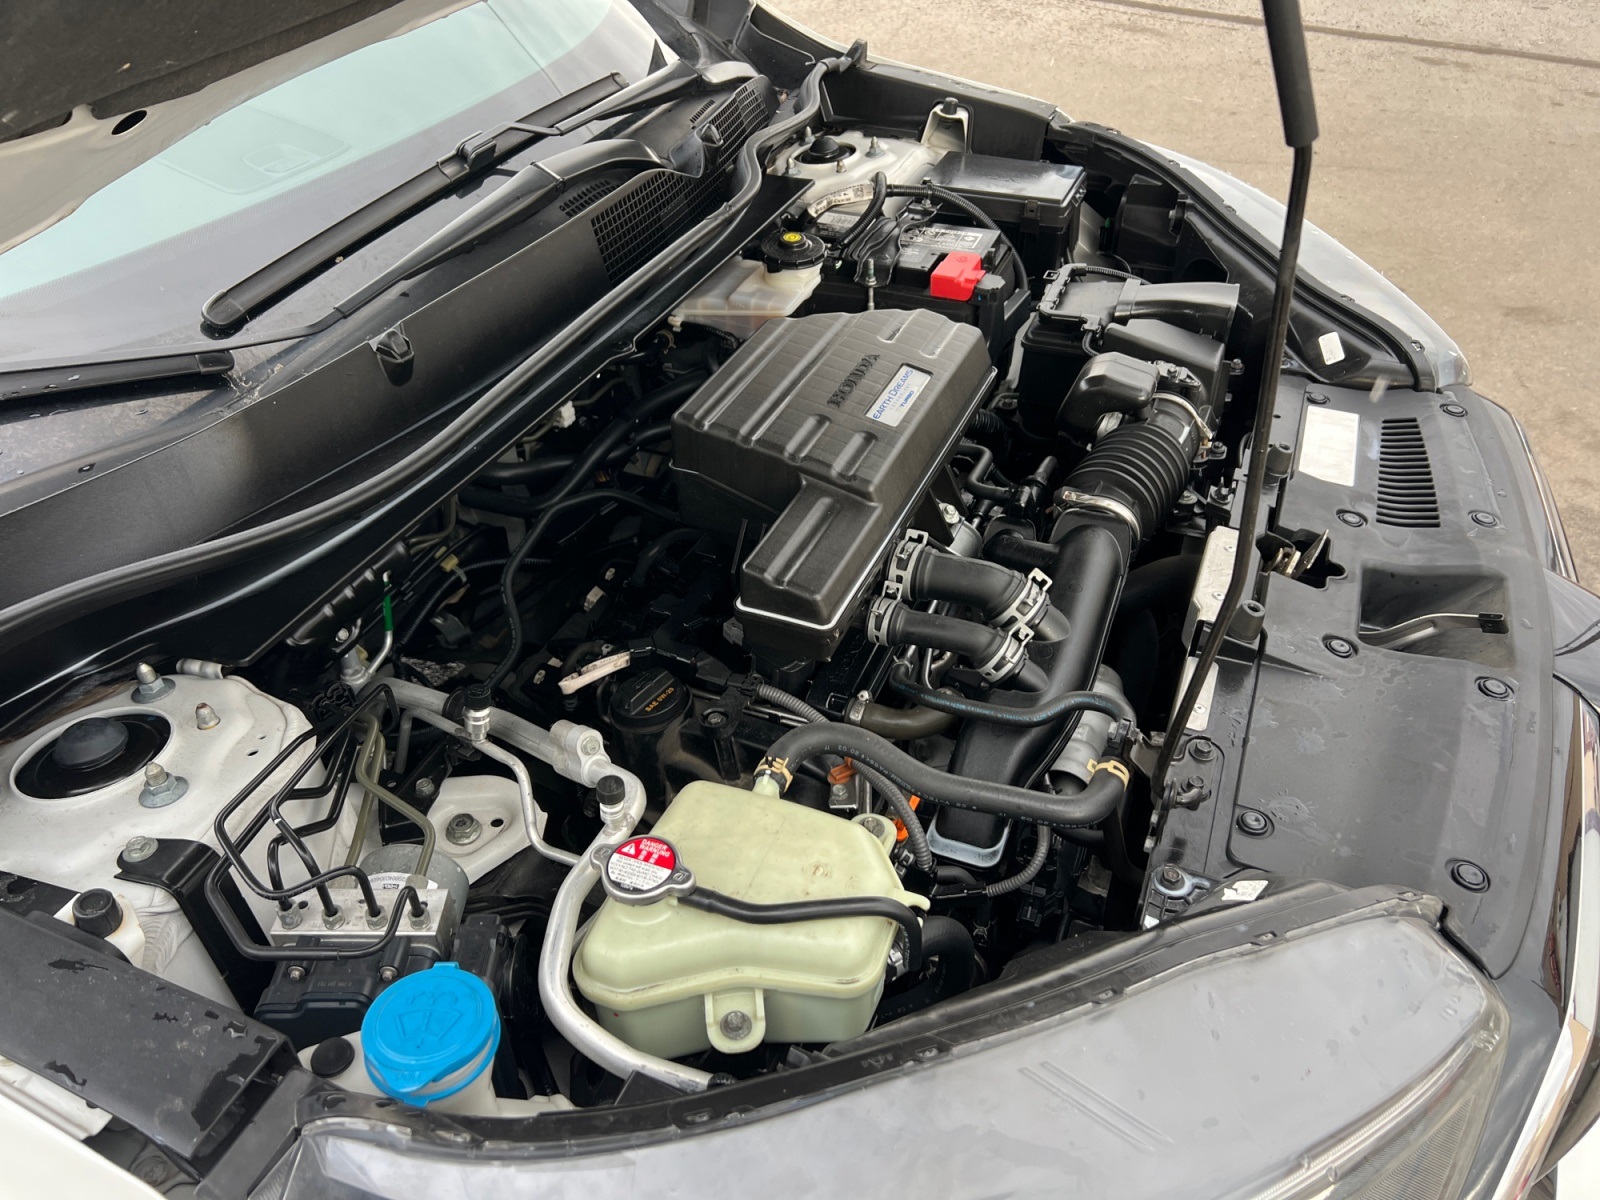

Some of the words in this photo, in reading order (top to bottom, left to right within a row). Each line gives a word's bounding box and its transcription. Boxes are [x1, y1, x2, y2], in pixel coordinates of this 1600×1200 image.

[827, 354, 880, 408] HONDA
[900, 390, 914, 407] TURBO
[873, 394, 893, 420] EARTH
[645, 701, 658, 712] SAE
[640, 844, 670, 857] WARNING
[642, 839, 667, 850] DANGER
